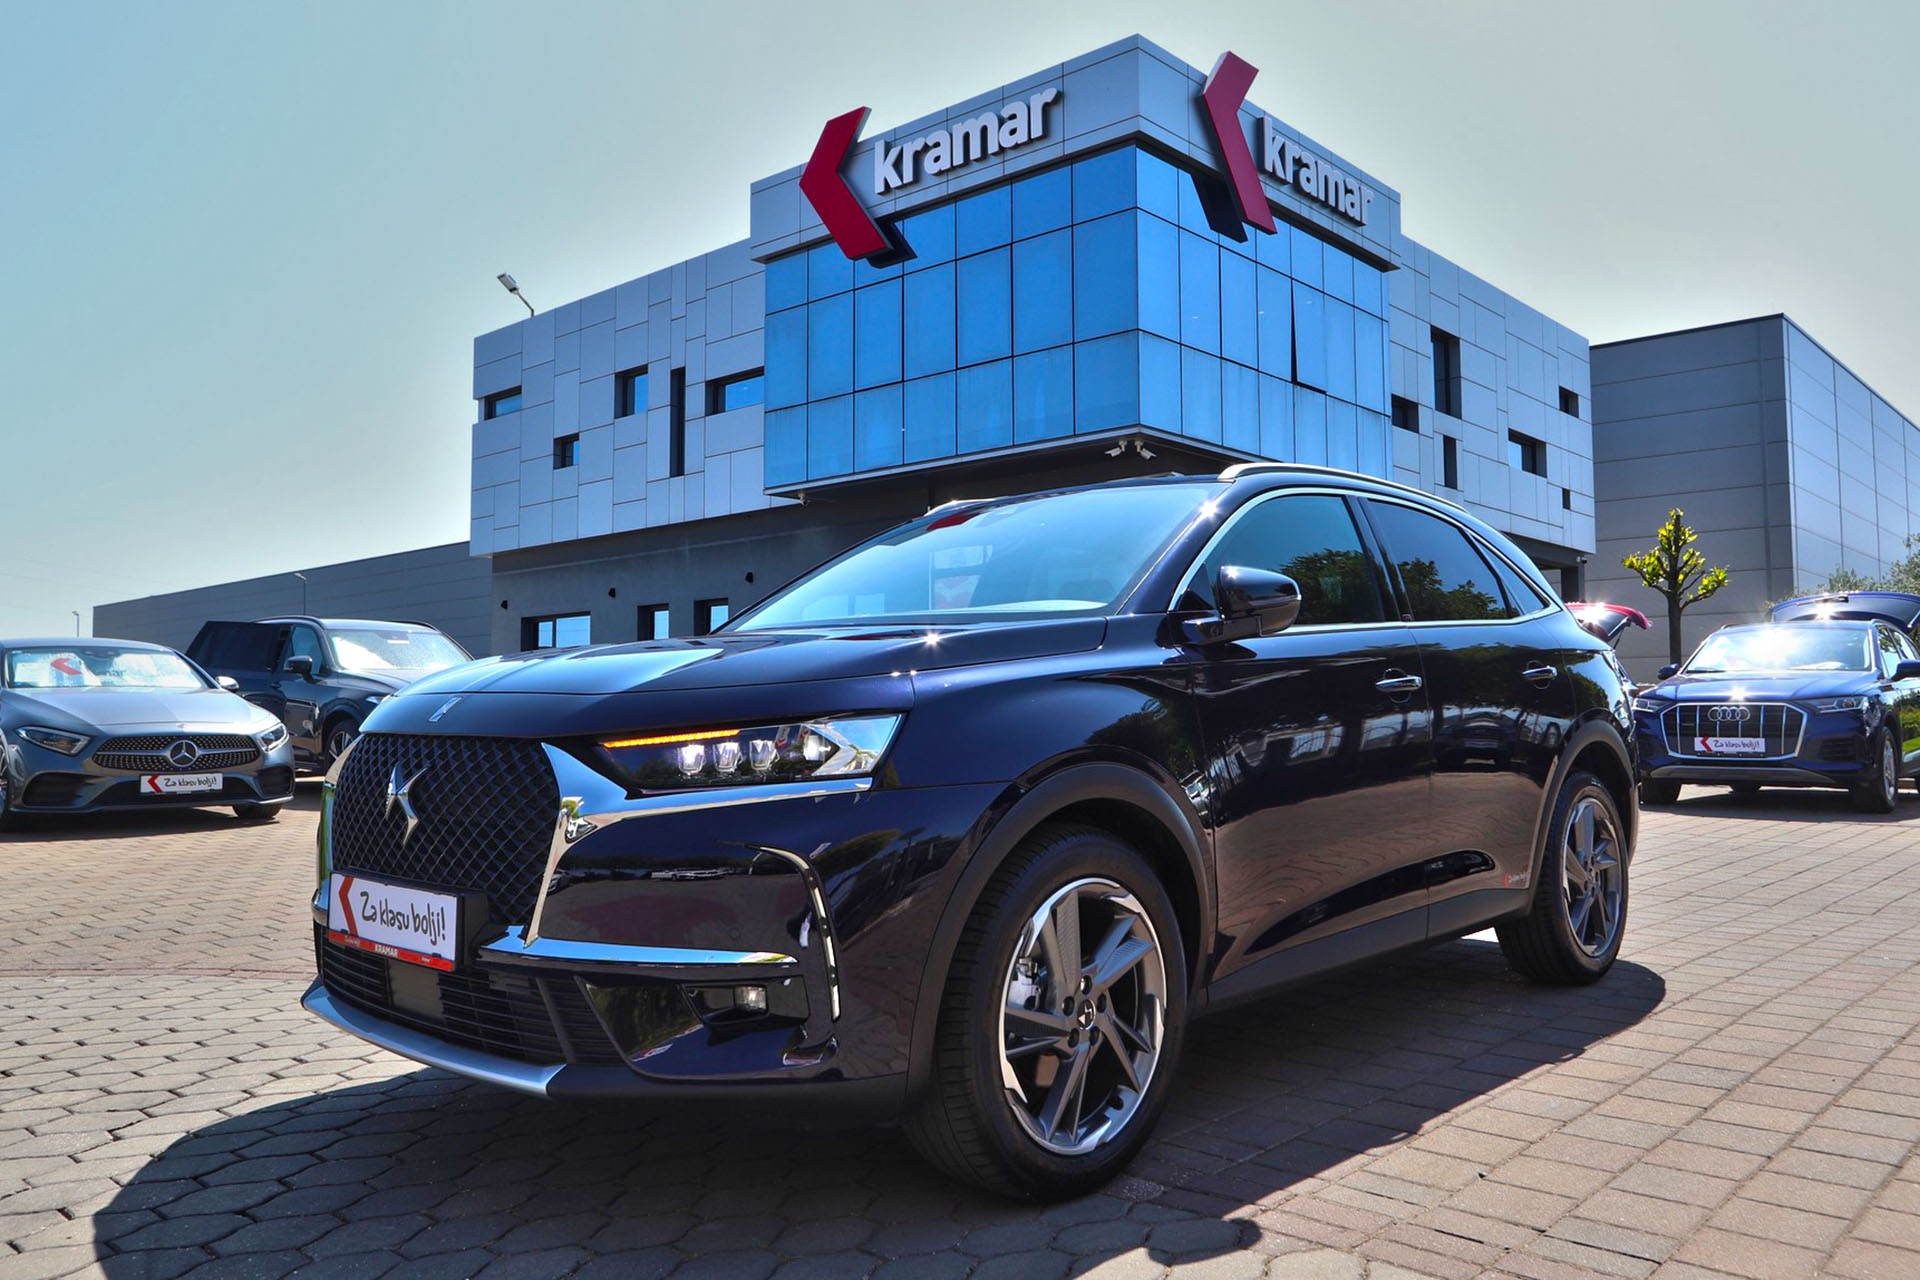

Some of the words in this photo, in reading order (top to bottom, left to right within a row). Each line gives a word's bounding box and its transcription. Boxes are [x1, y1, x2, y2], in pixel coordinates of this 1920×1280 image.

[874, 87, 1058, 196] kramar
[1262, 117, 1374, 225] kramar
[164, 778, 176, 786] Za
[360, 891, 378, 922] Za
[379, 898, 410, 931] klasu
[411, 903, 446, 946] bolji!
[375, 944, 400, 958] KRAMAR
